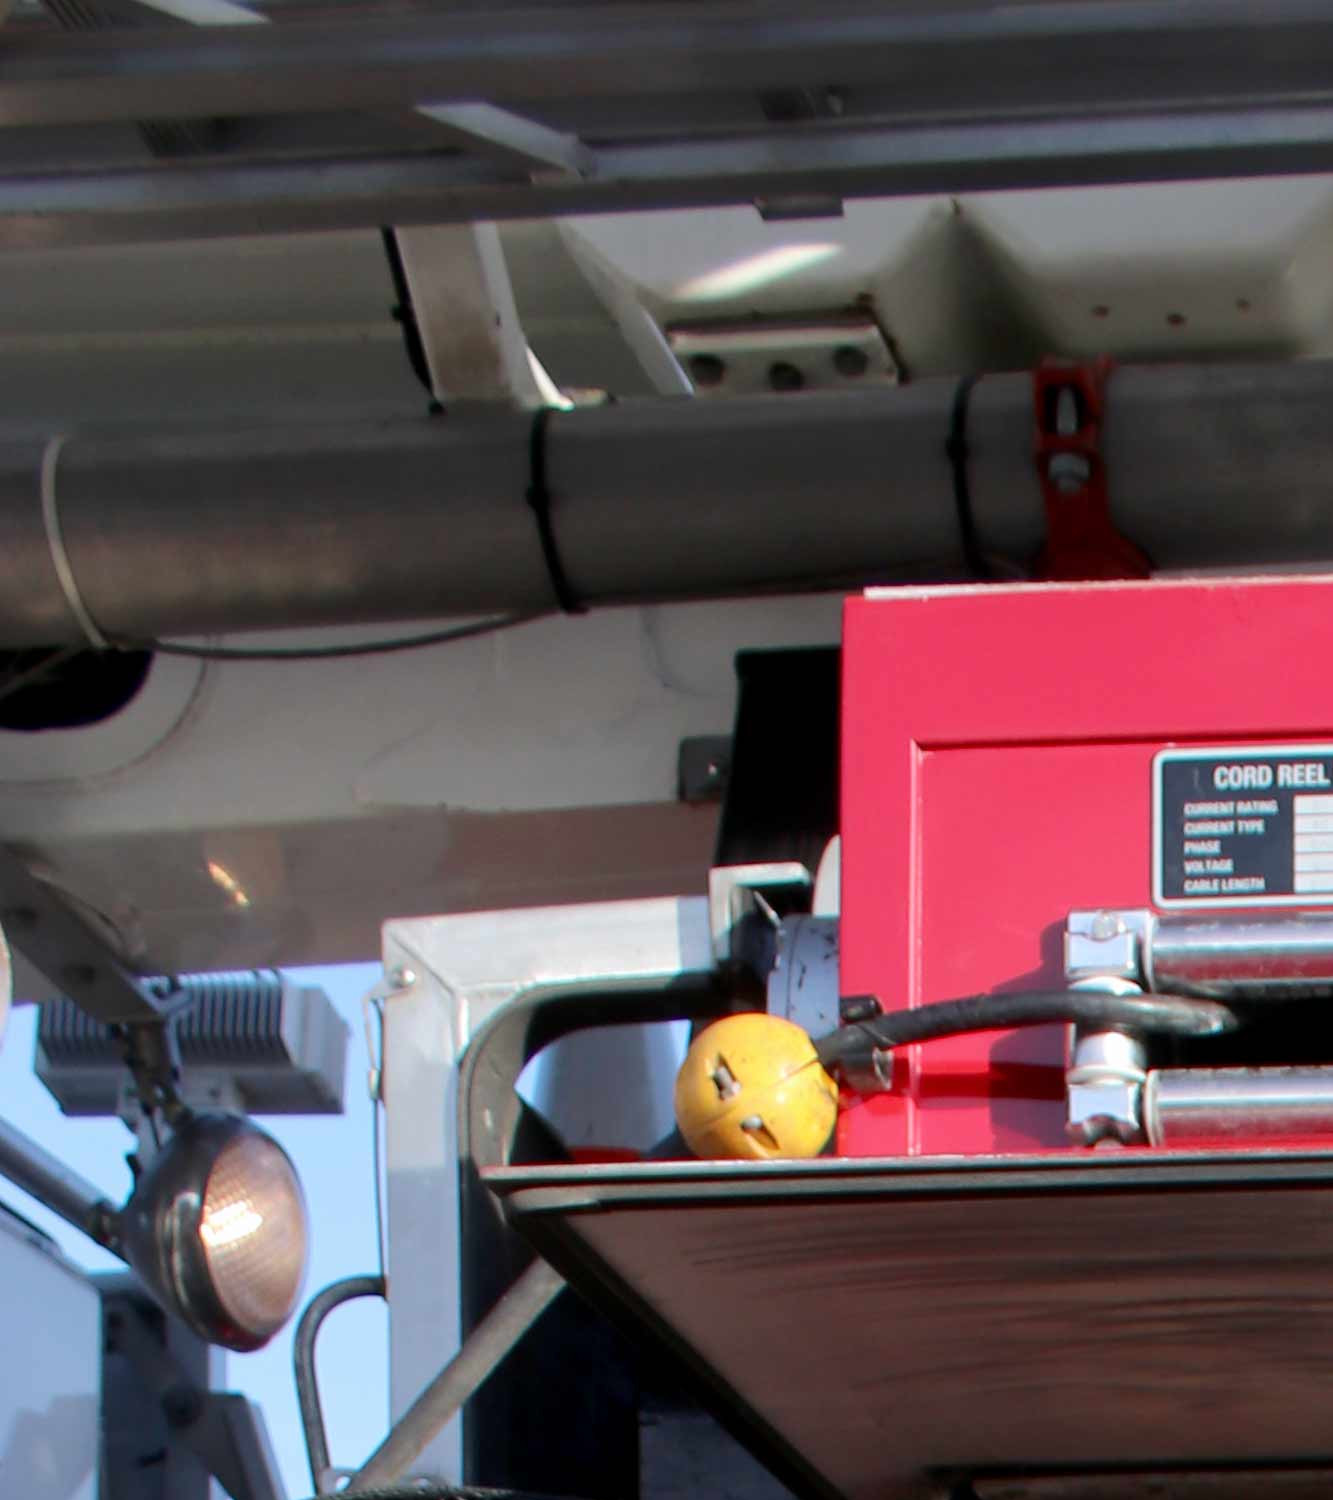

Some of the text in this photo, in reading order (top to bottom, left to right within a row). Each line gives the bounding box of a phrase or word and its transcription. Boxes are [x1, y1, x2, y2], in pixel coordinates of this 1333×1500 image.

[1213, 765, 1273, 790] CORD
[1277, 763, 1331, 789] REEL
[1184, 799, 1279, 817] CURRENT RATING
[1184, 818, 1265, 836] CURRENT TYPE
[1184, 840, 1221, 857] PHASE
[1184, 858, 1234, 876] VOLTAGE
[1184, 876, 1266, 895] CABLE LENGTH
